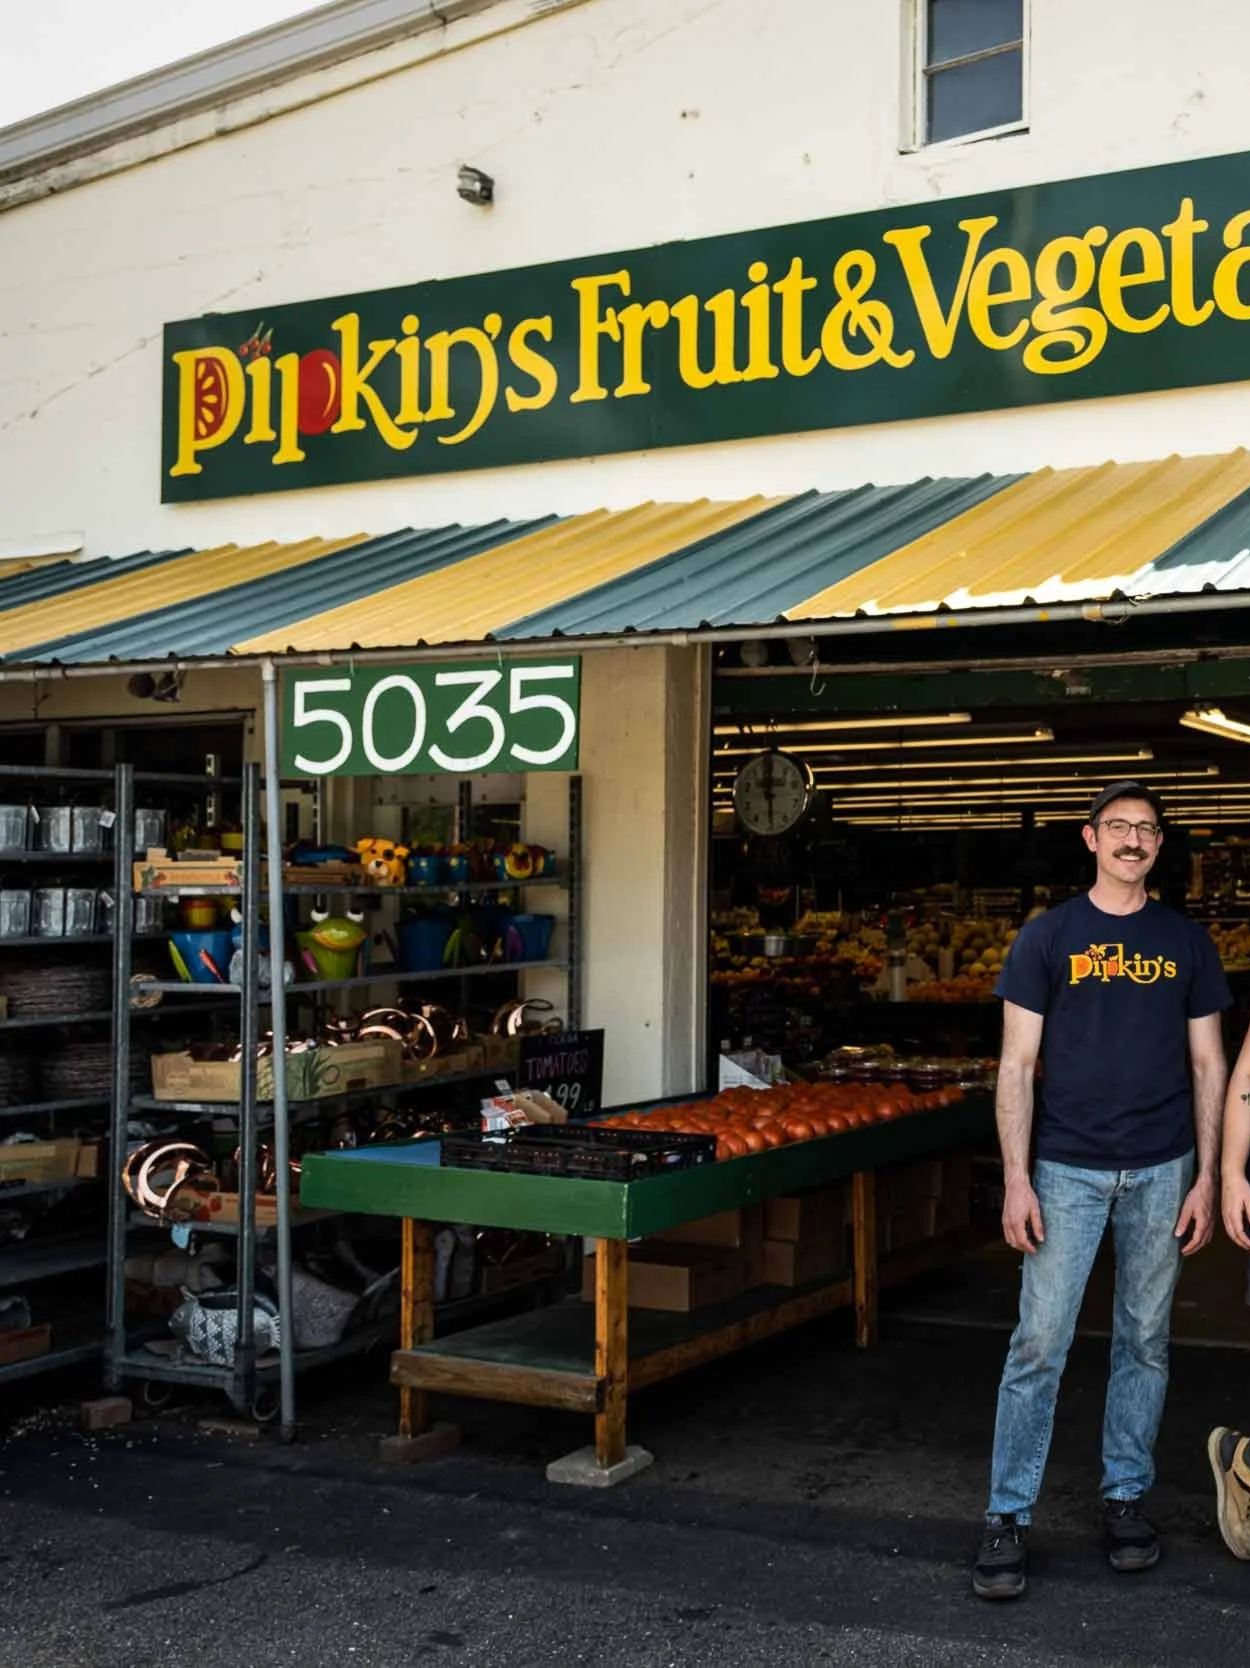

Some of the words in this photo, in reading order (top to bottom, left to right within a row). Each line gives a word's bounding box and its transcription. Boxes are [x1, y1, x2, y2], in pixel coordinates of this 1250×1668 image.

[170, 312, 558, 477] Pipkin's
[571, 256, 823, 403] Fruit
[821, 249, 914, 371] &
[294, 664, 576, 775] 5035
[1069, 943, 1177, 984] Pipkin's
